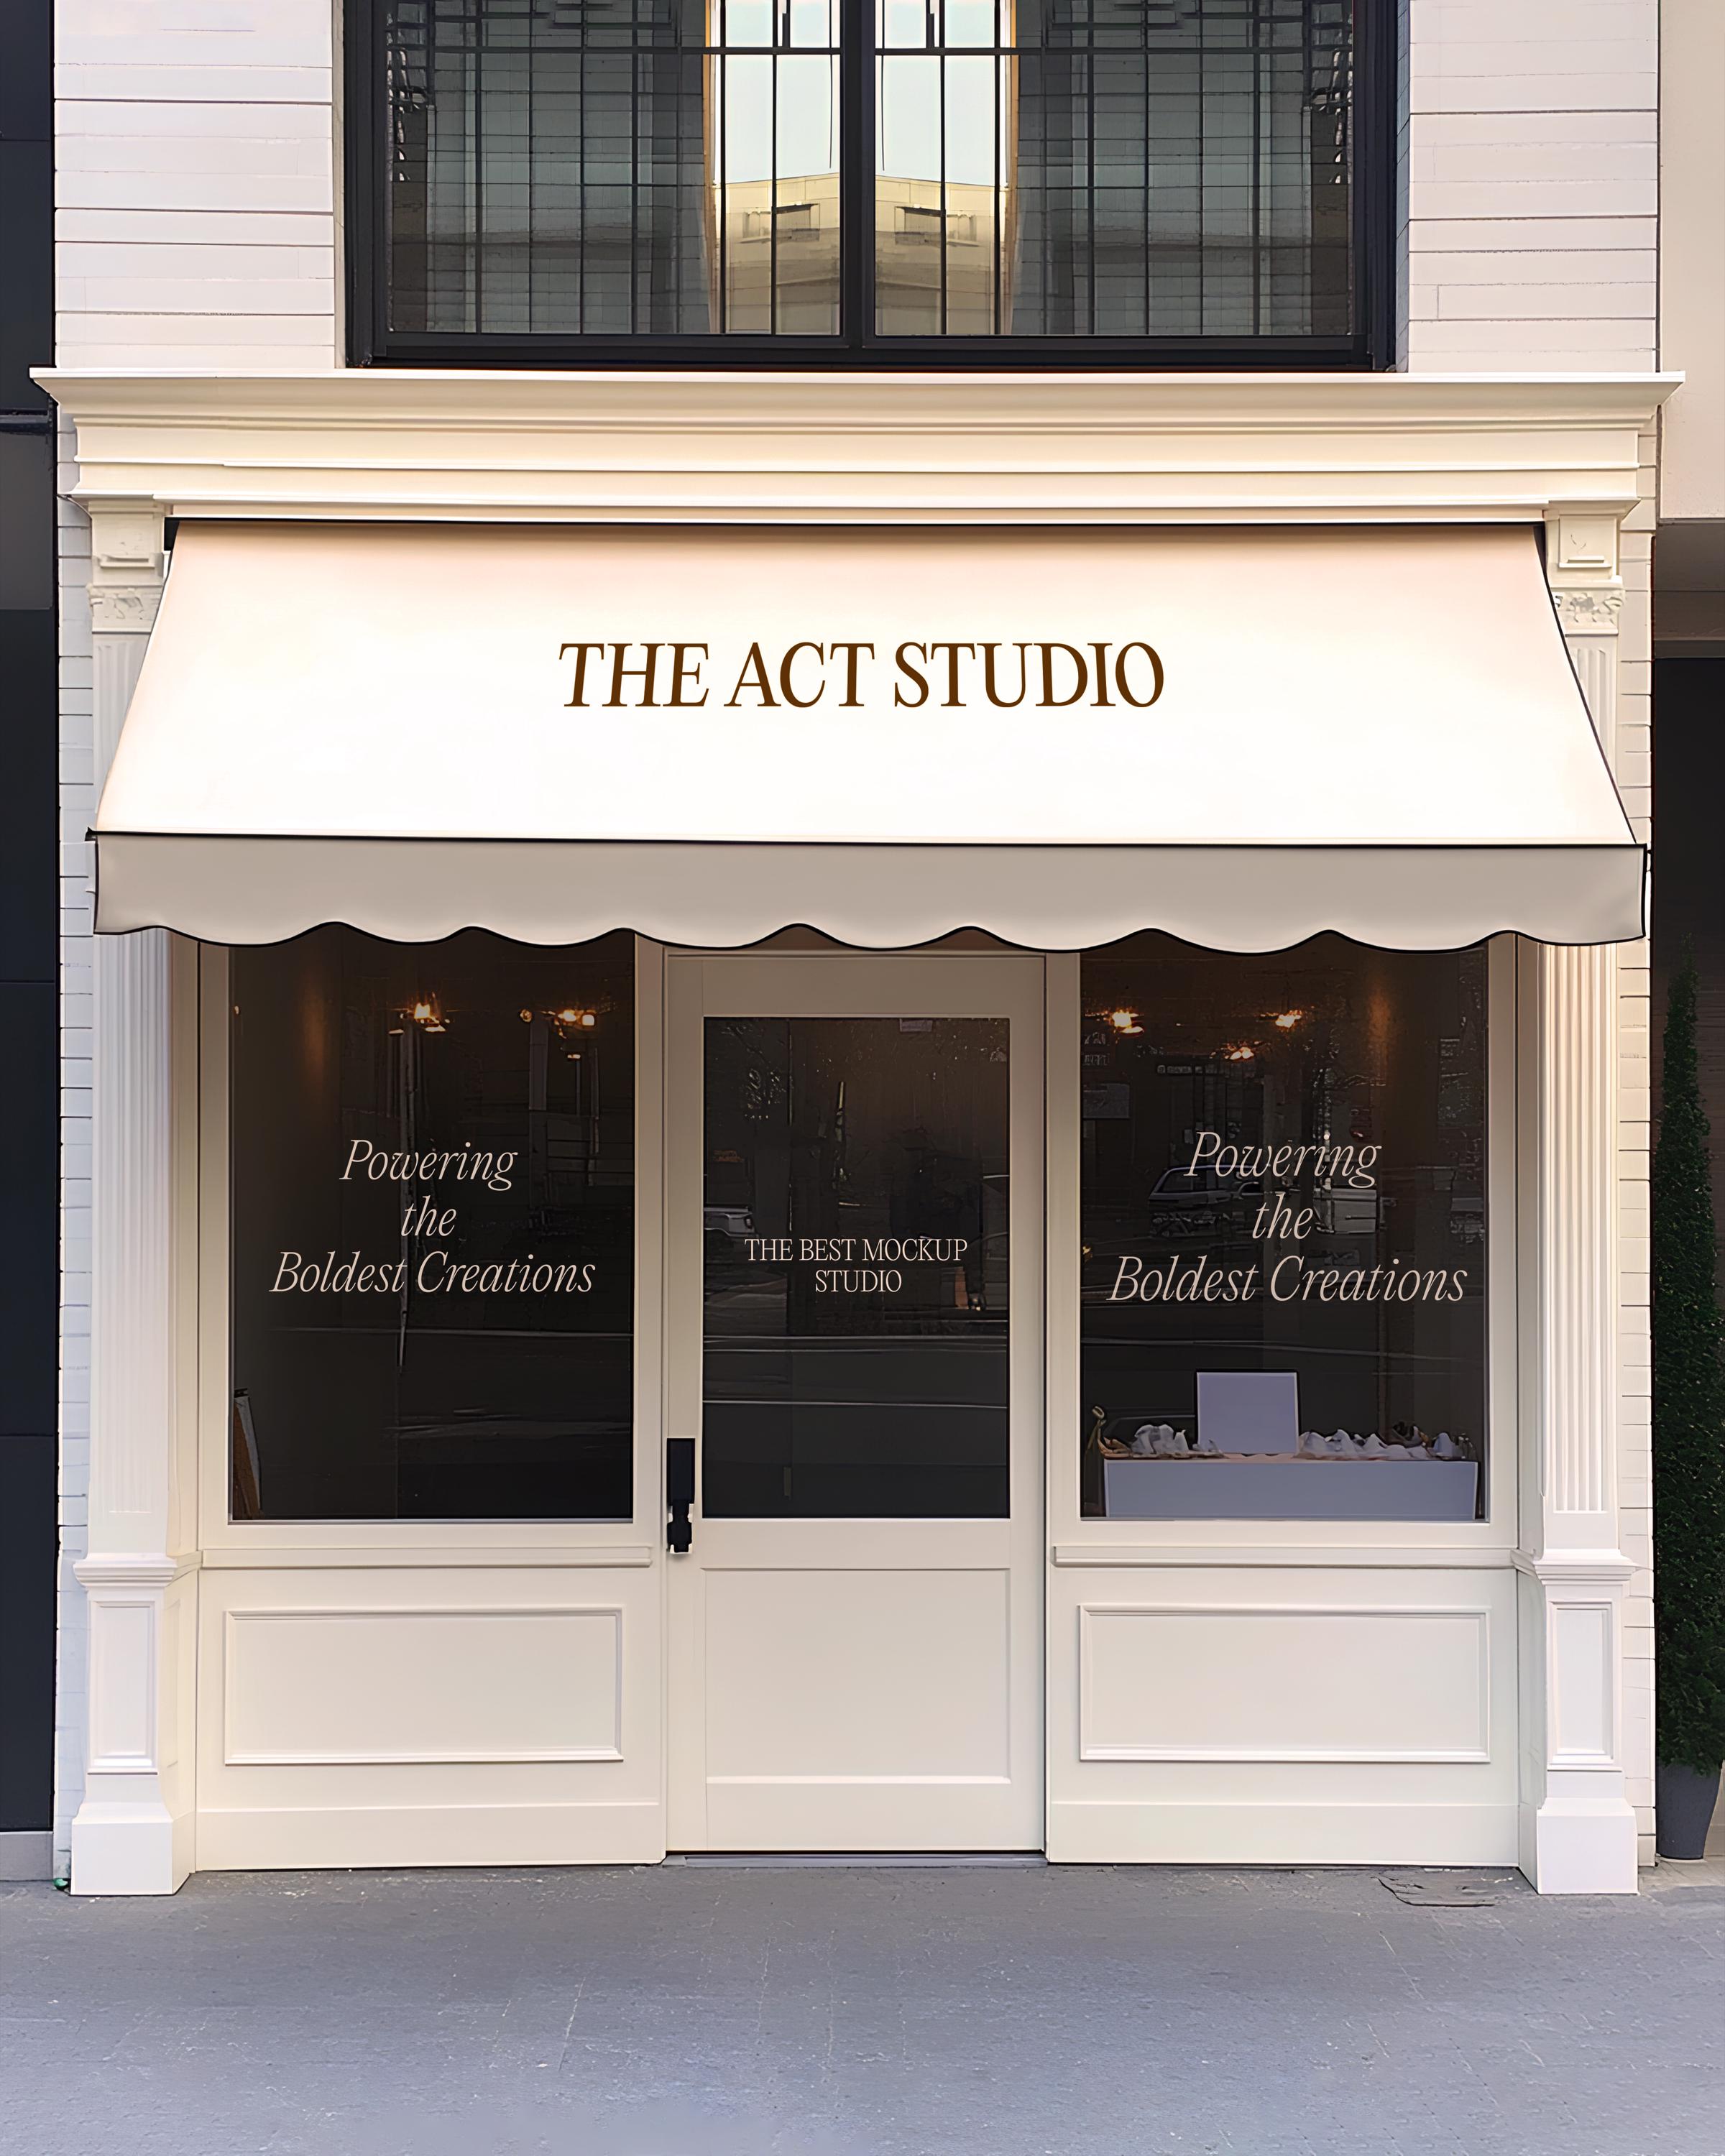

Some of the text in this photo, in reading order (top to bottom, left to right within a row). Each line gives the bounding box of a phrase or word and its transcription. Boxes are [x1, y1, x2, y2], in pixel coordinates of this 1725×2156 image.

[559, 642, 1164, 708] THE ACT STUDIO
[339, 1139, 518, 1192] Powering
[1183, 1131, 1382, 1189] Powering
[400, 1194, 456, 1237] the
[1252, 1191, 1313, 1240] the
[269, 1250, 596, 1293] Boldest Creations
[744, 1238, 967, 1261] THE BEST MOCKUP
[815, 1269, 902, 1293] STUDIO
[1105, 1254, 1468, 1302] Boldest Creations
